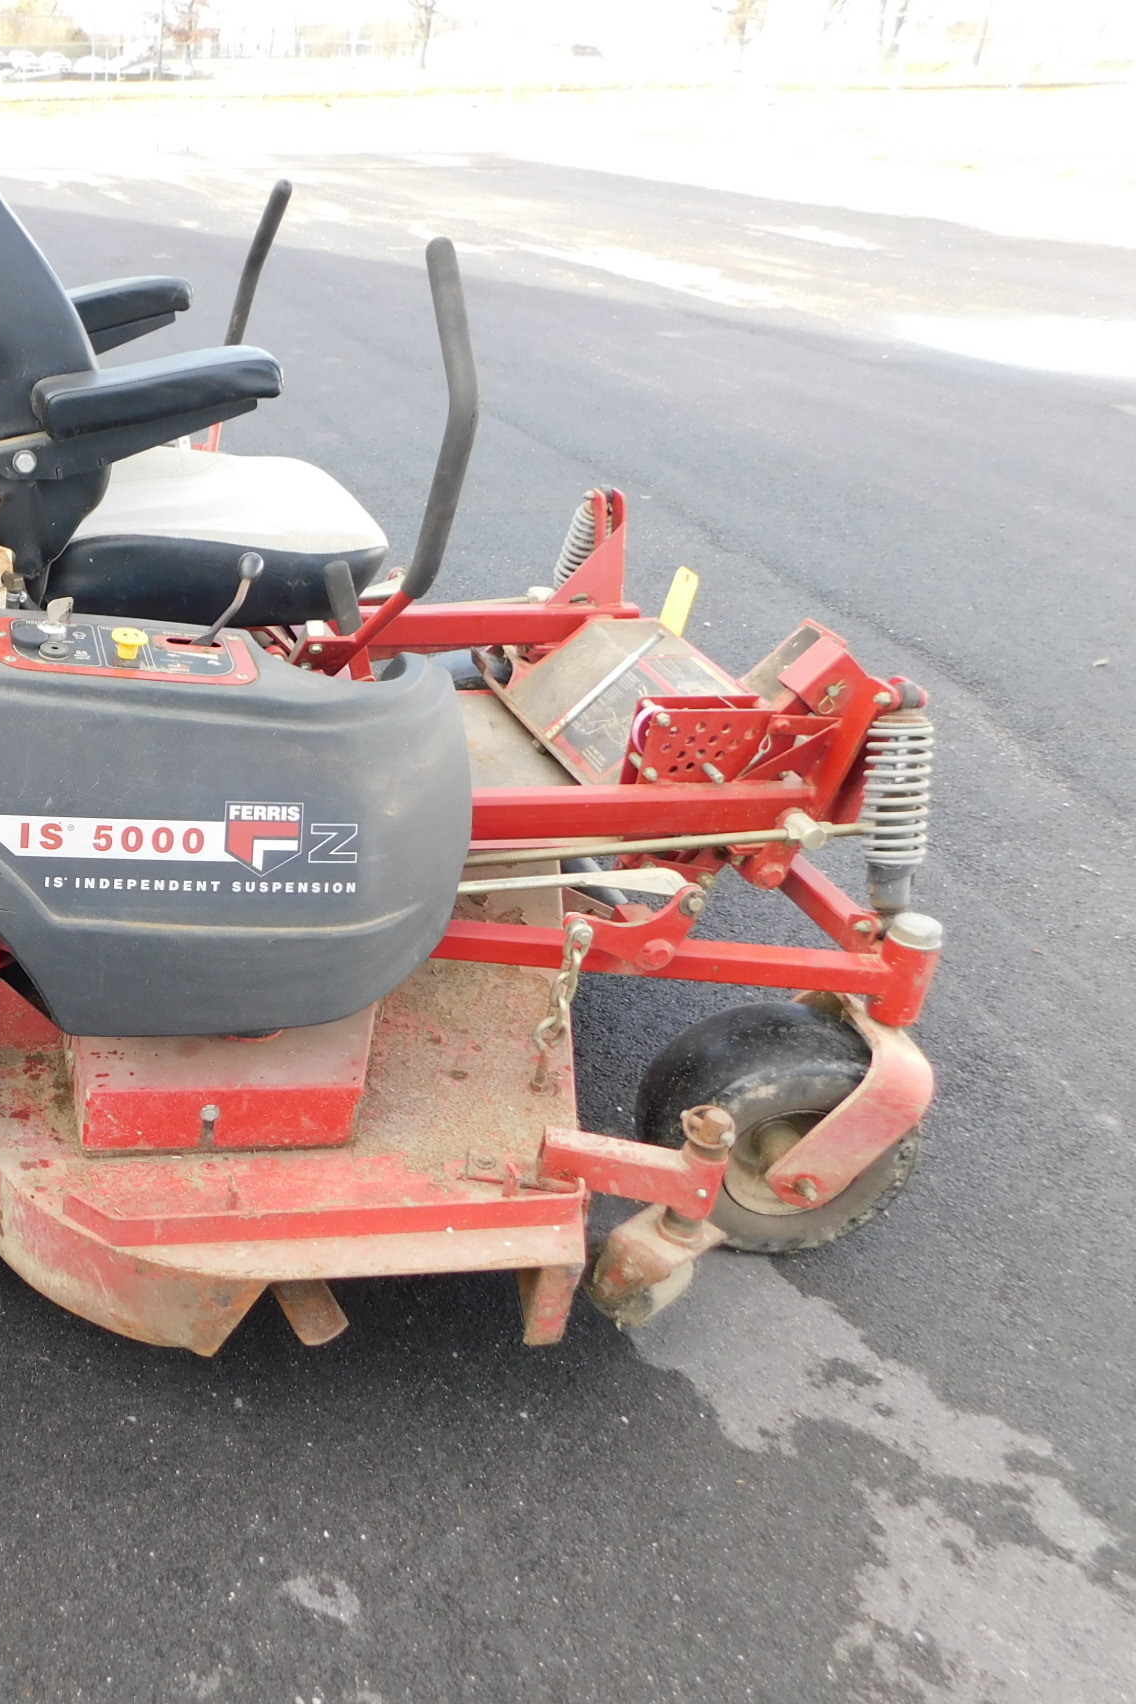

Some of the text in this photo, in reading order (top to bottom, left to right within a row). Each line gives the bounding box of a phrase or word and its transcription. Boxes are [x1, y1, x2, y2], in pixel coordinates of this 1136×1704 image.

[229, 804, 300, 822] FERRIS
[92, 825, 206, 854] 5000
[75, 877, 221, 892] INDEPENDENT
[231, 881, 357, 894] SUSPENSION
